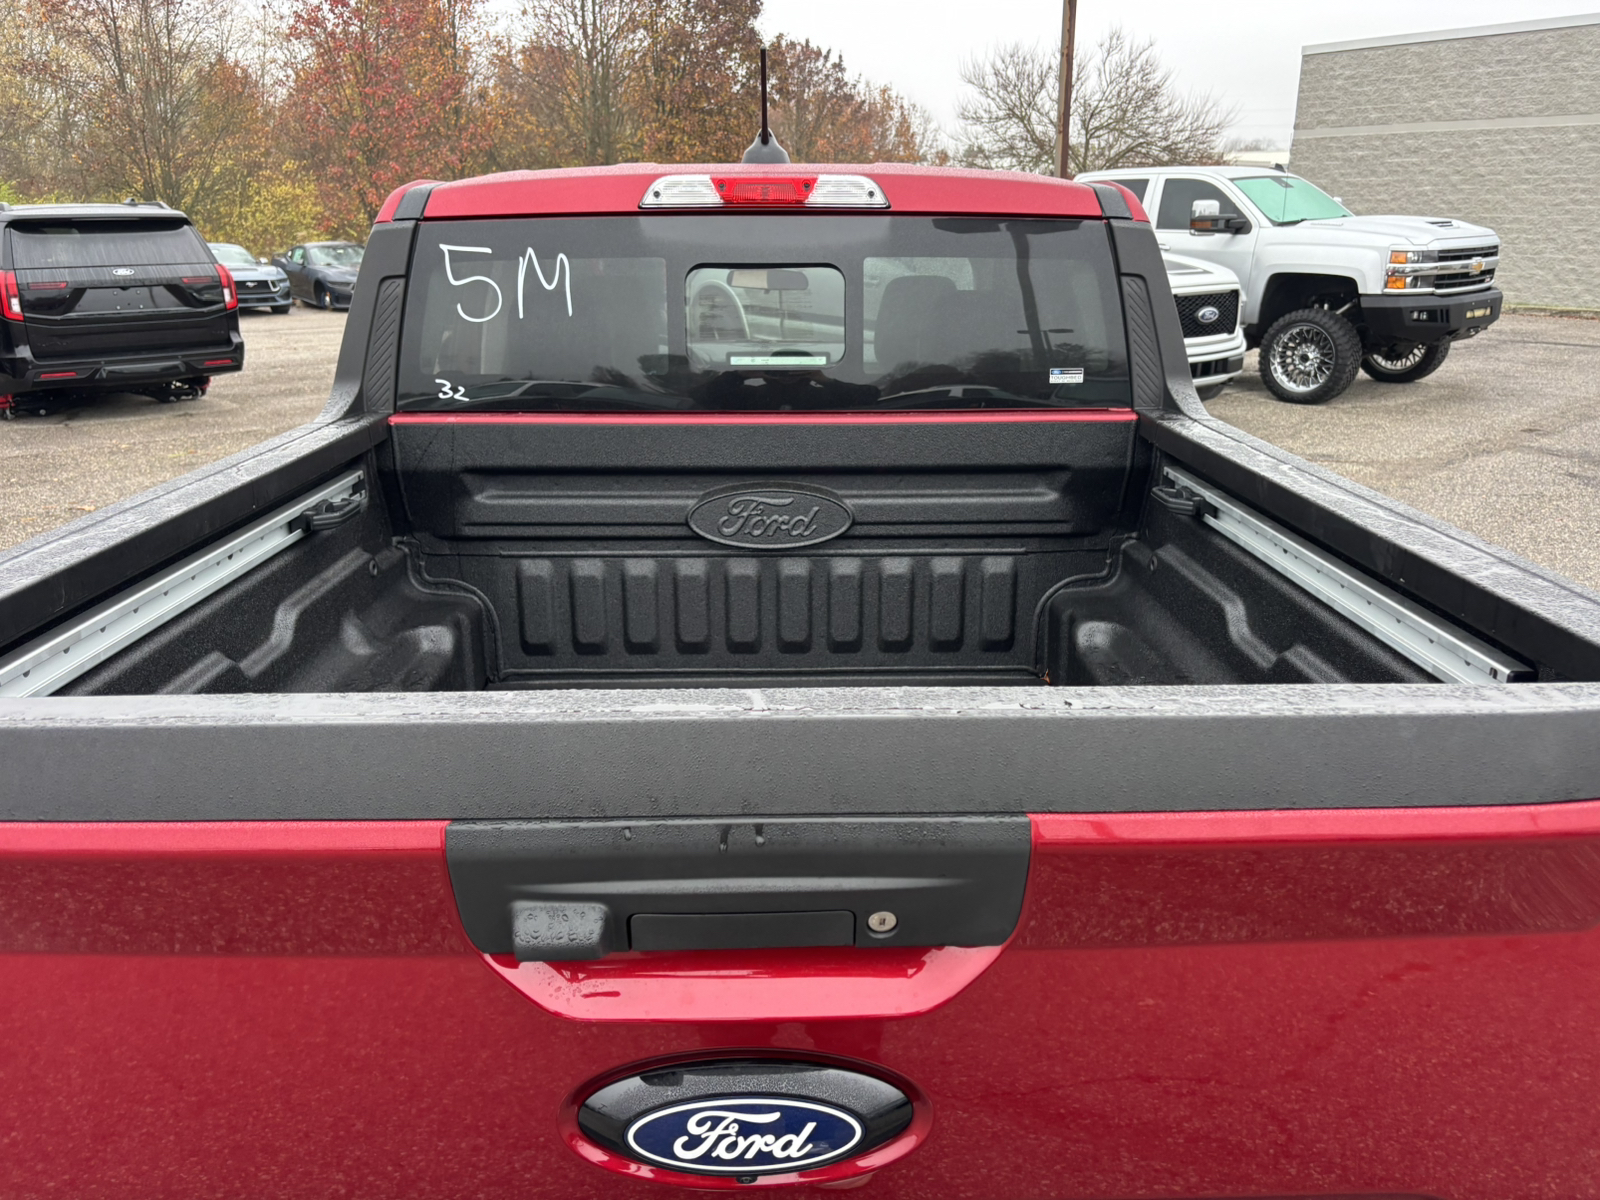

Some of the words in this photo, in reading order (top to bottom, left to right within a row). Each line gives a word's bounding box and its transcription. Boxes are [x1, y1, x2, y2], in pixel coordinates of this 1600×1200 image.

[435, 378, 470, 401] 32
[717, 496, 820, 538] Ford
[673, 1110, 818, 1160] Ford
